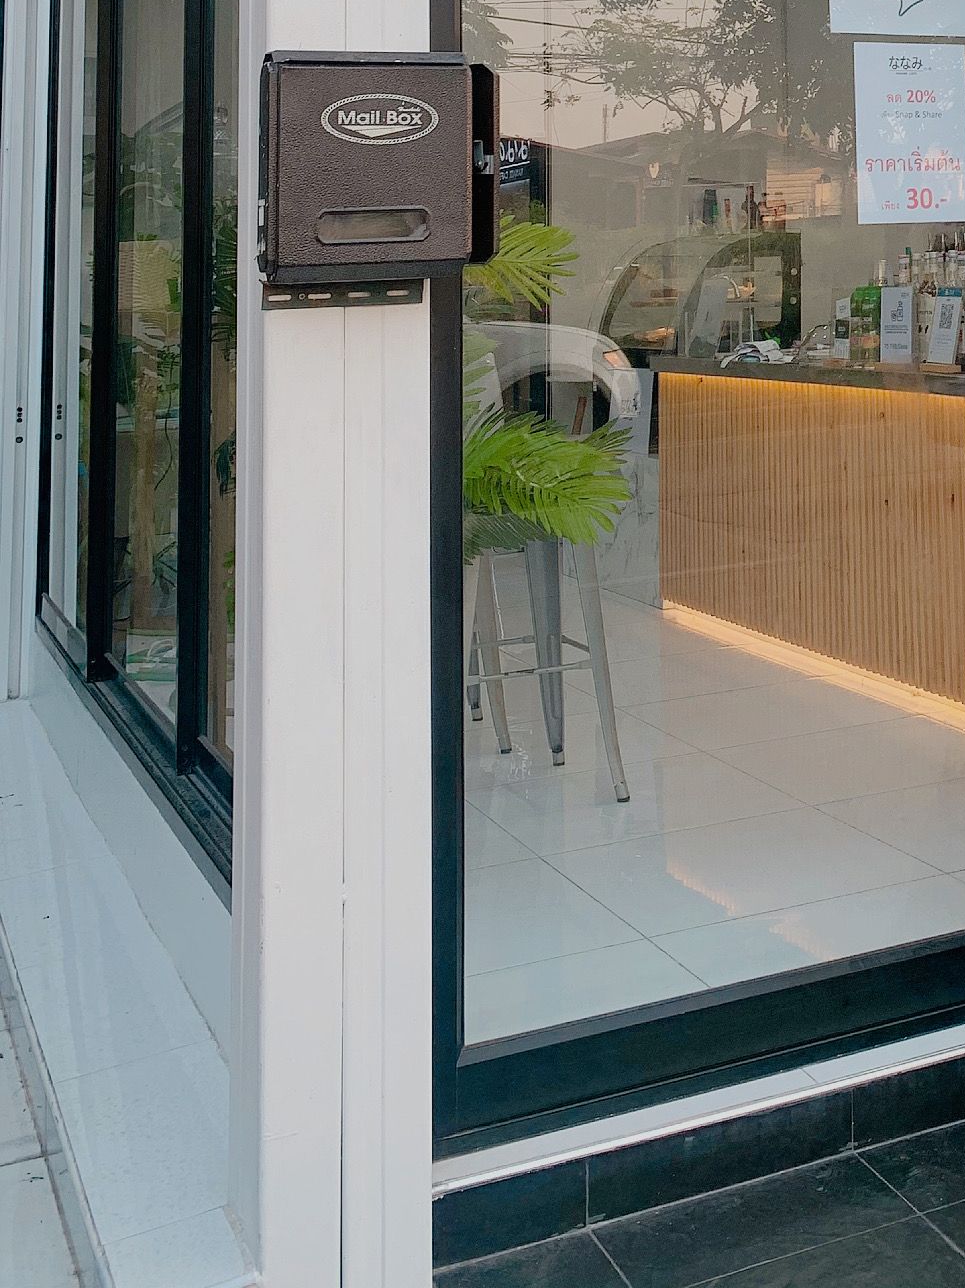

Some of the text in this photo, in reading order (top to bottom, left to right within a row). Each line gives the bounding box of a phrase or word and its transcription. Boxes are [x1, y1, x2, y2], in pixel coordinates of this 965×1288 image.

[889, 55, 923, 70] ななみ
[906, 89, 936, 104] 20%
[337, 110, 423, 125] Mail Box
[895, 111, 913, 119] Snap
[922, 111, 943, 119] Share
[865, 145, 961, 172] ราคาเริ่มต้น
[906, 188, 947, 209] 30.-
